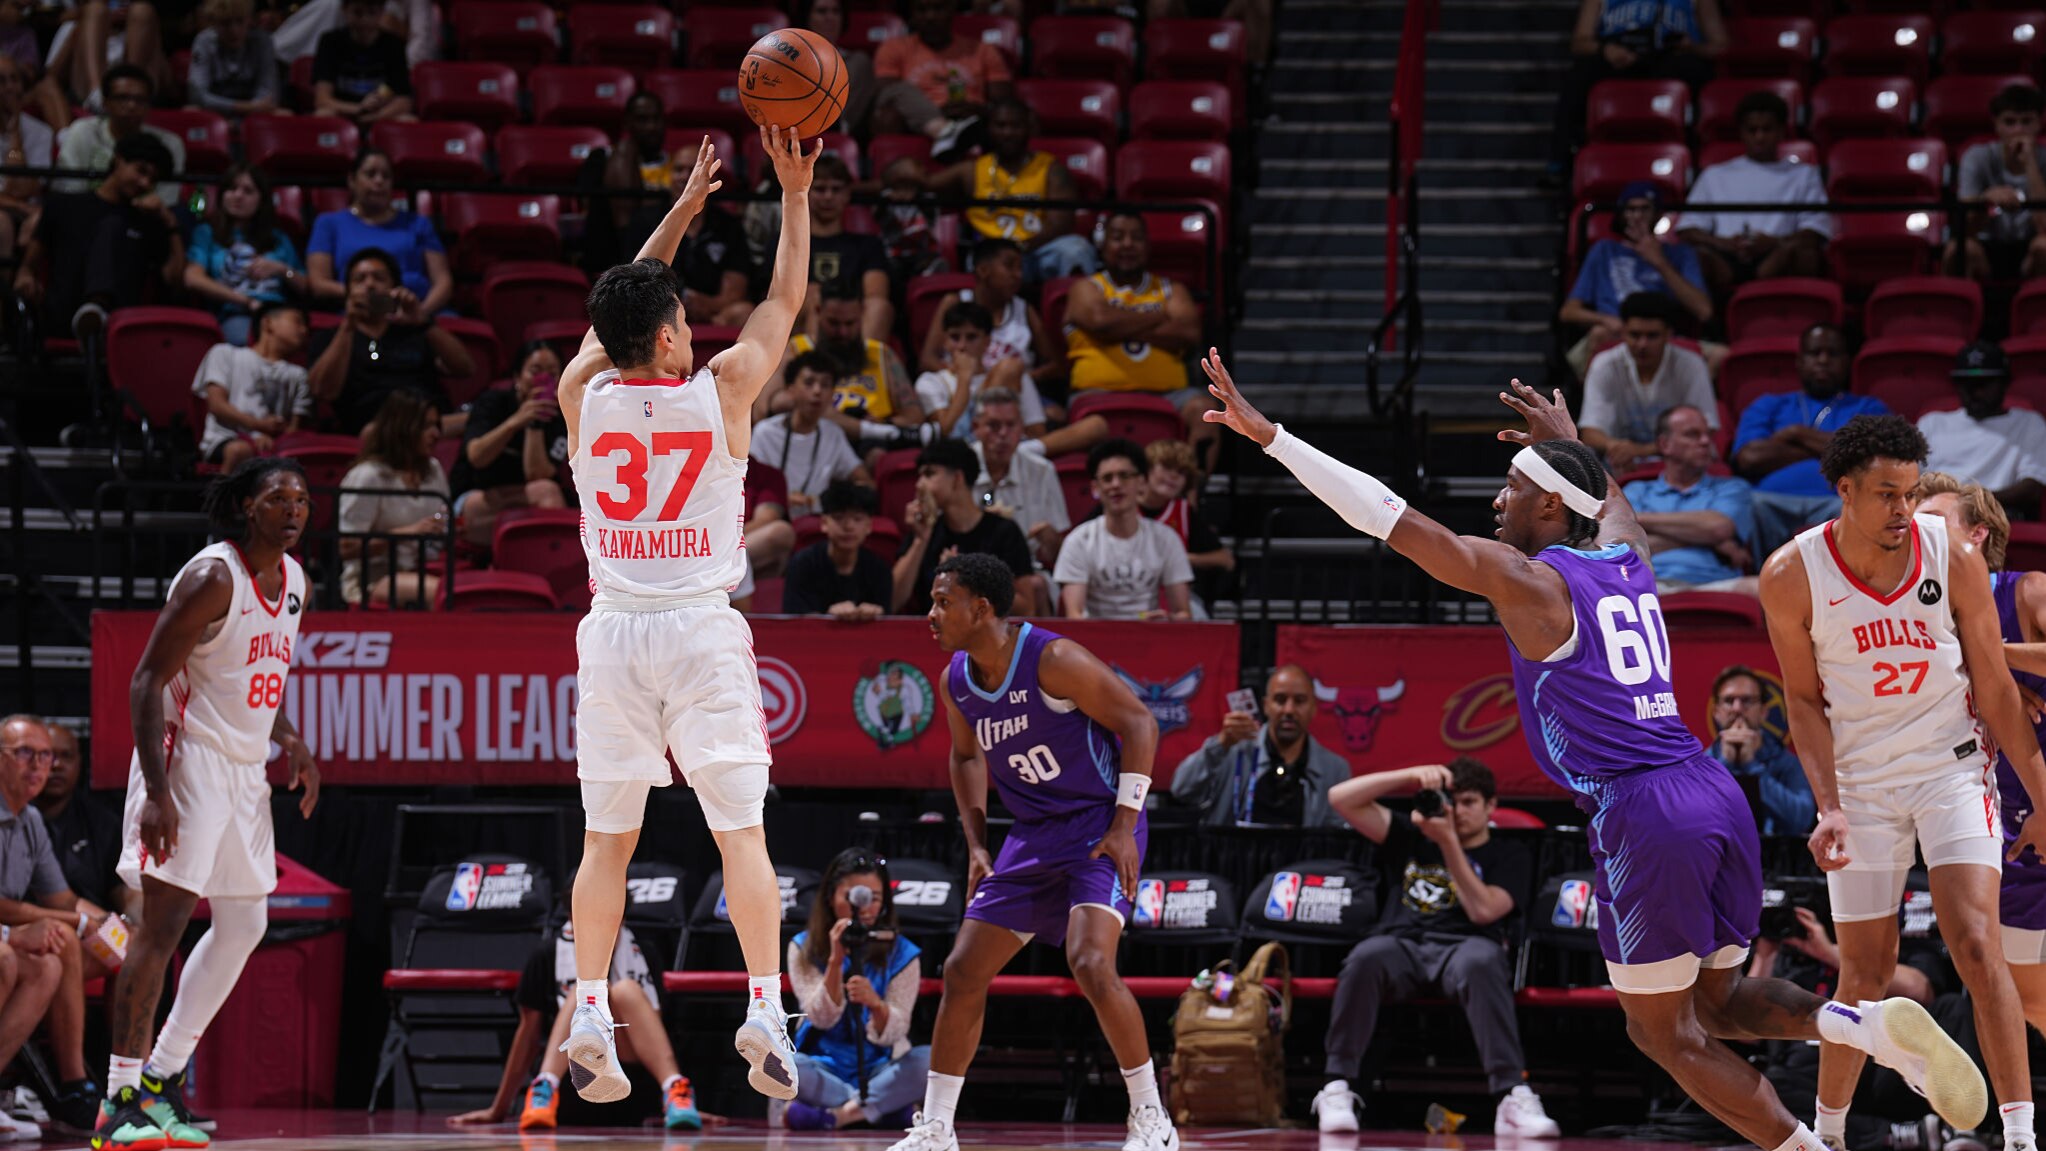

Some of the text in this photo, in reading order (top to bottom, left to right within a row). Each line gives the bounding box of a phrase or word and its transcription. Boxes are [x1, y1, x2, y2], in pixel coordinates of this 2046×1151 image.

[591, 431, 713, 522] 37
[598, 527, 712, 560] KAWAMURA
[290, 631, 393, 668] K26
[1596, 593, 1671, 686] 60
[1852, 617, 1937, 654] BULLS
[247, 672, 282, 709] 88
[1009, 689, 1028, 704] LVT
[1872, 660, 1930, 697] 27
[268, 673, 579, 762] UMMER LEAG
[976, 714, 1028, 752] UTAH
[1008, 744, 1061, 784] 30
[626, 876, 678, 904] 26
[890, 880, 951, 906] 26
